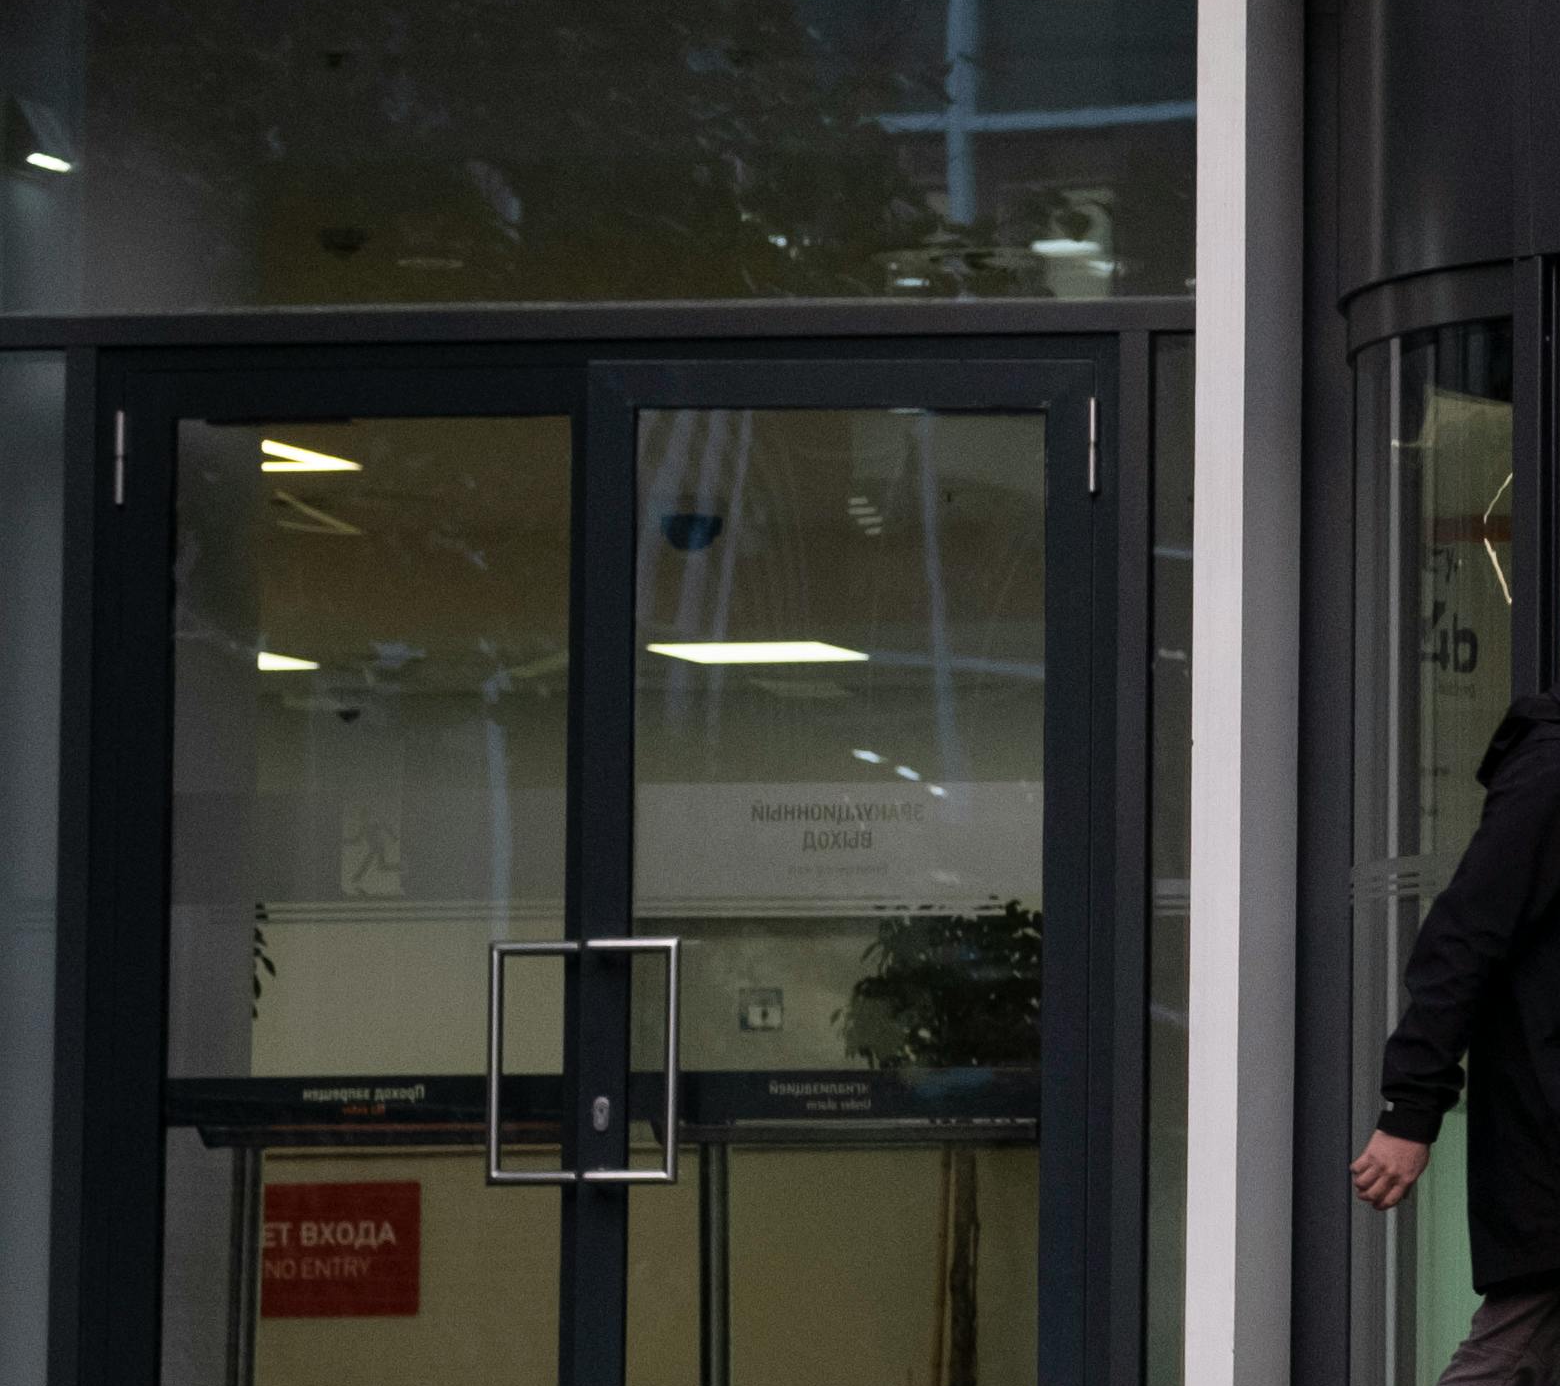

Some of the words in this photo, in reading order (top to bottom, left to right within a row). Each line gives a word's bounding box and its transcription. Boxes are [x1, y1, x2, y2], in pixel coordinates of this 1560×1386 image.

[301, 1219, 397, 1250] ВХОДА
[264, 1259, 296, 1280] NO
[301, 1256, 372, 1280] ENTRY
